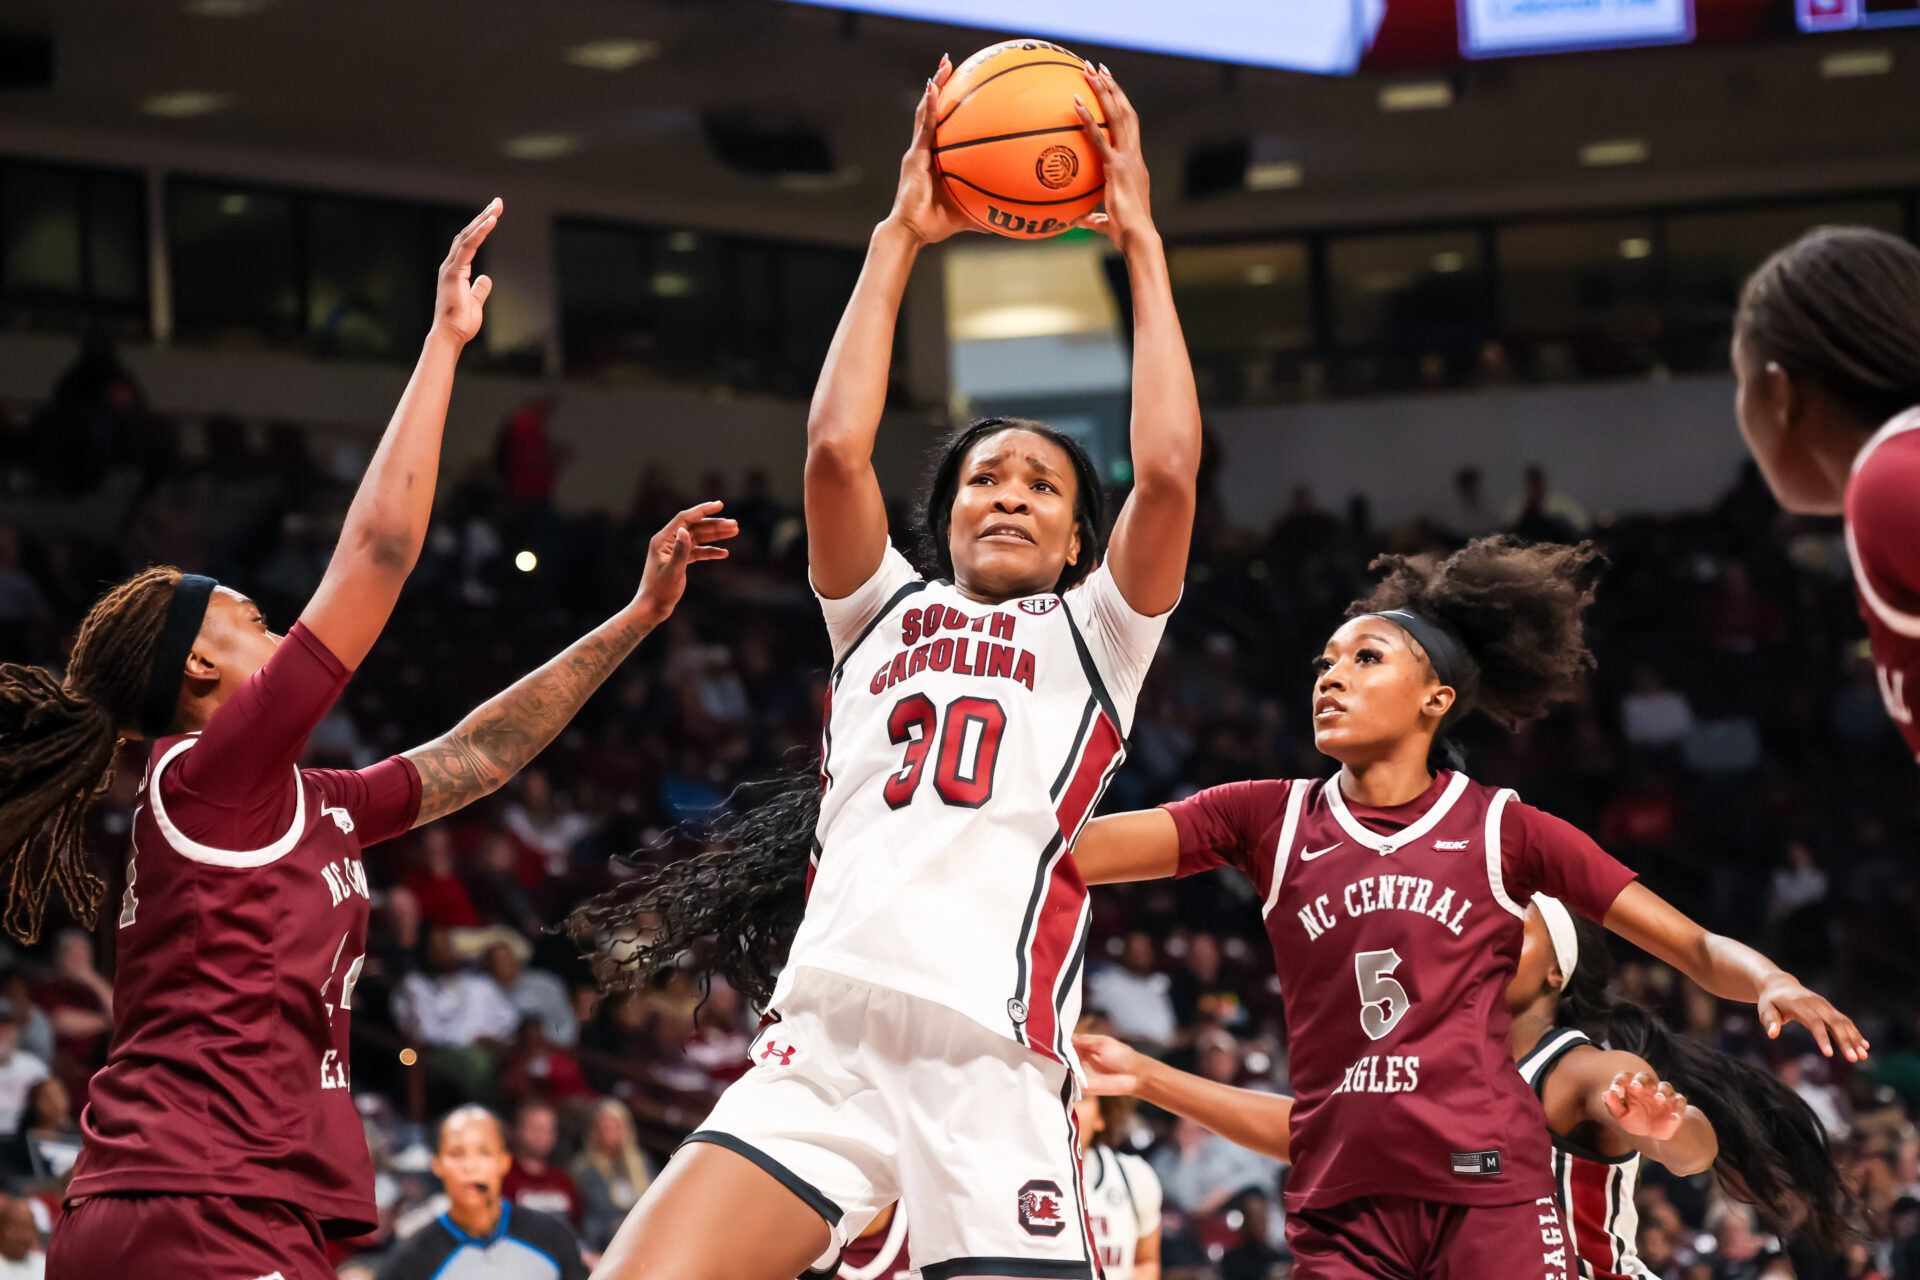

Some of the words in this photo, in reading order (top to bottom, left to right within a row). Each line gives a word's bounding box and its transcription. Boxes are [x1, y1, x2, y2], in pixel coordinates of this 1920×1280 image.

[902, 603, 1016, 646] SOUTH
[869, 637, 1036, 695] CAROLINA
[883, 691, 1007, 810] 30
[1297, 894, 1337, 942] NC
[1343, 874, 1473, 936] CENTRAL
[1355, 948, 1411, 1040] 5
[1331, 1055, 1420, 1096] AGLES
[1486, 1157, 1496, 1168] M
